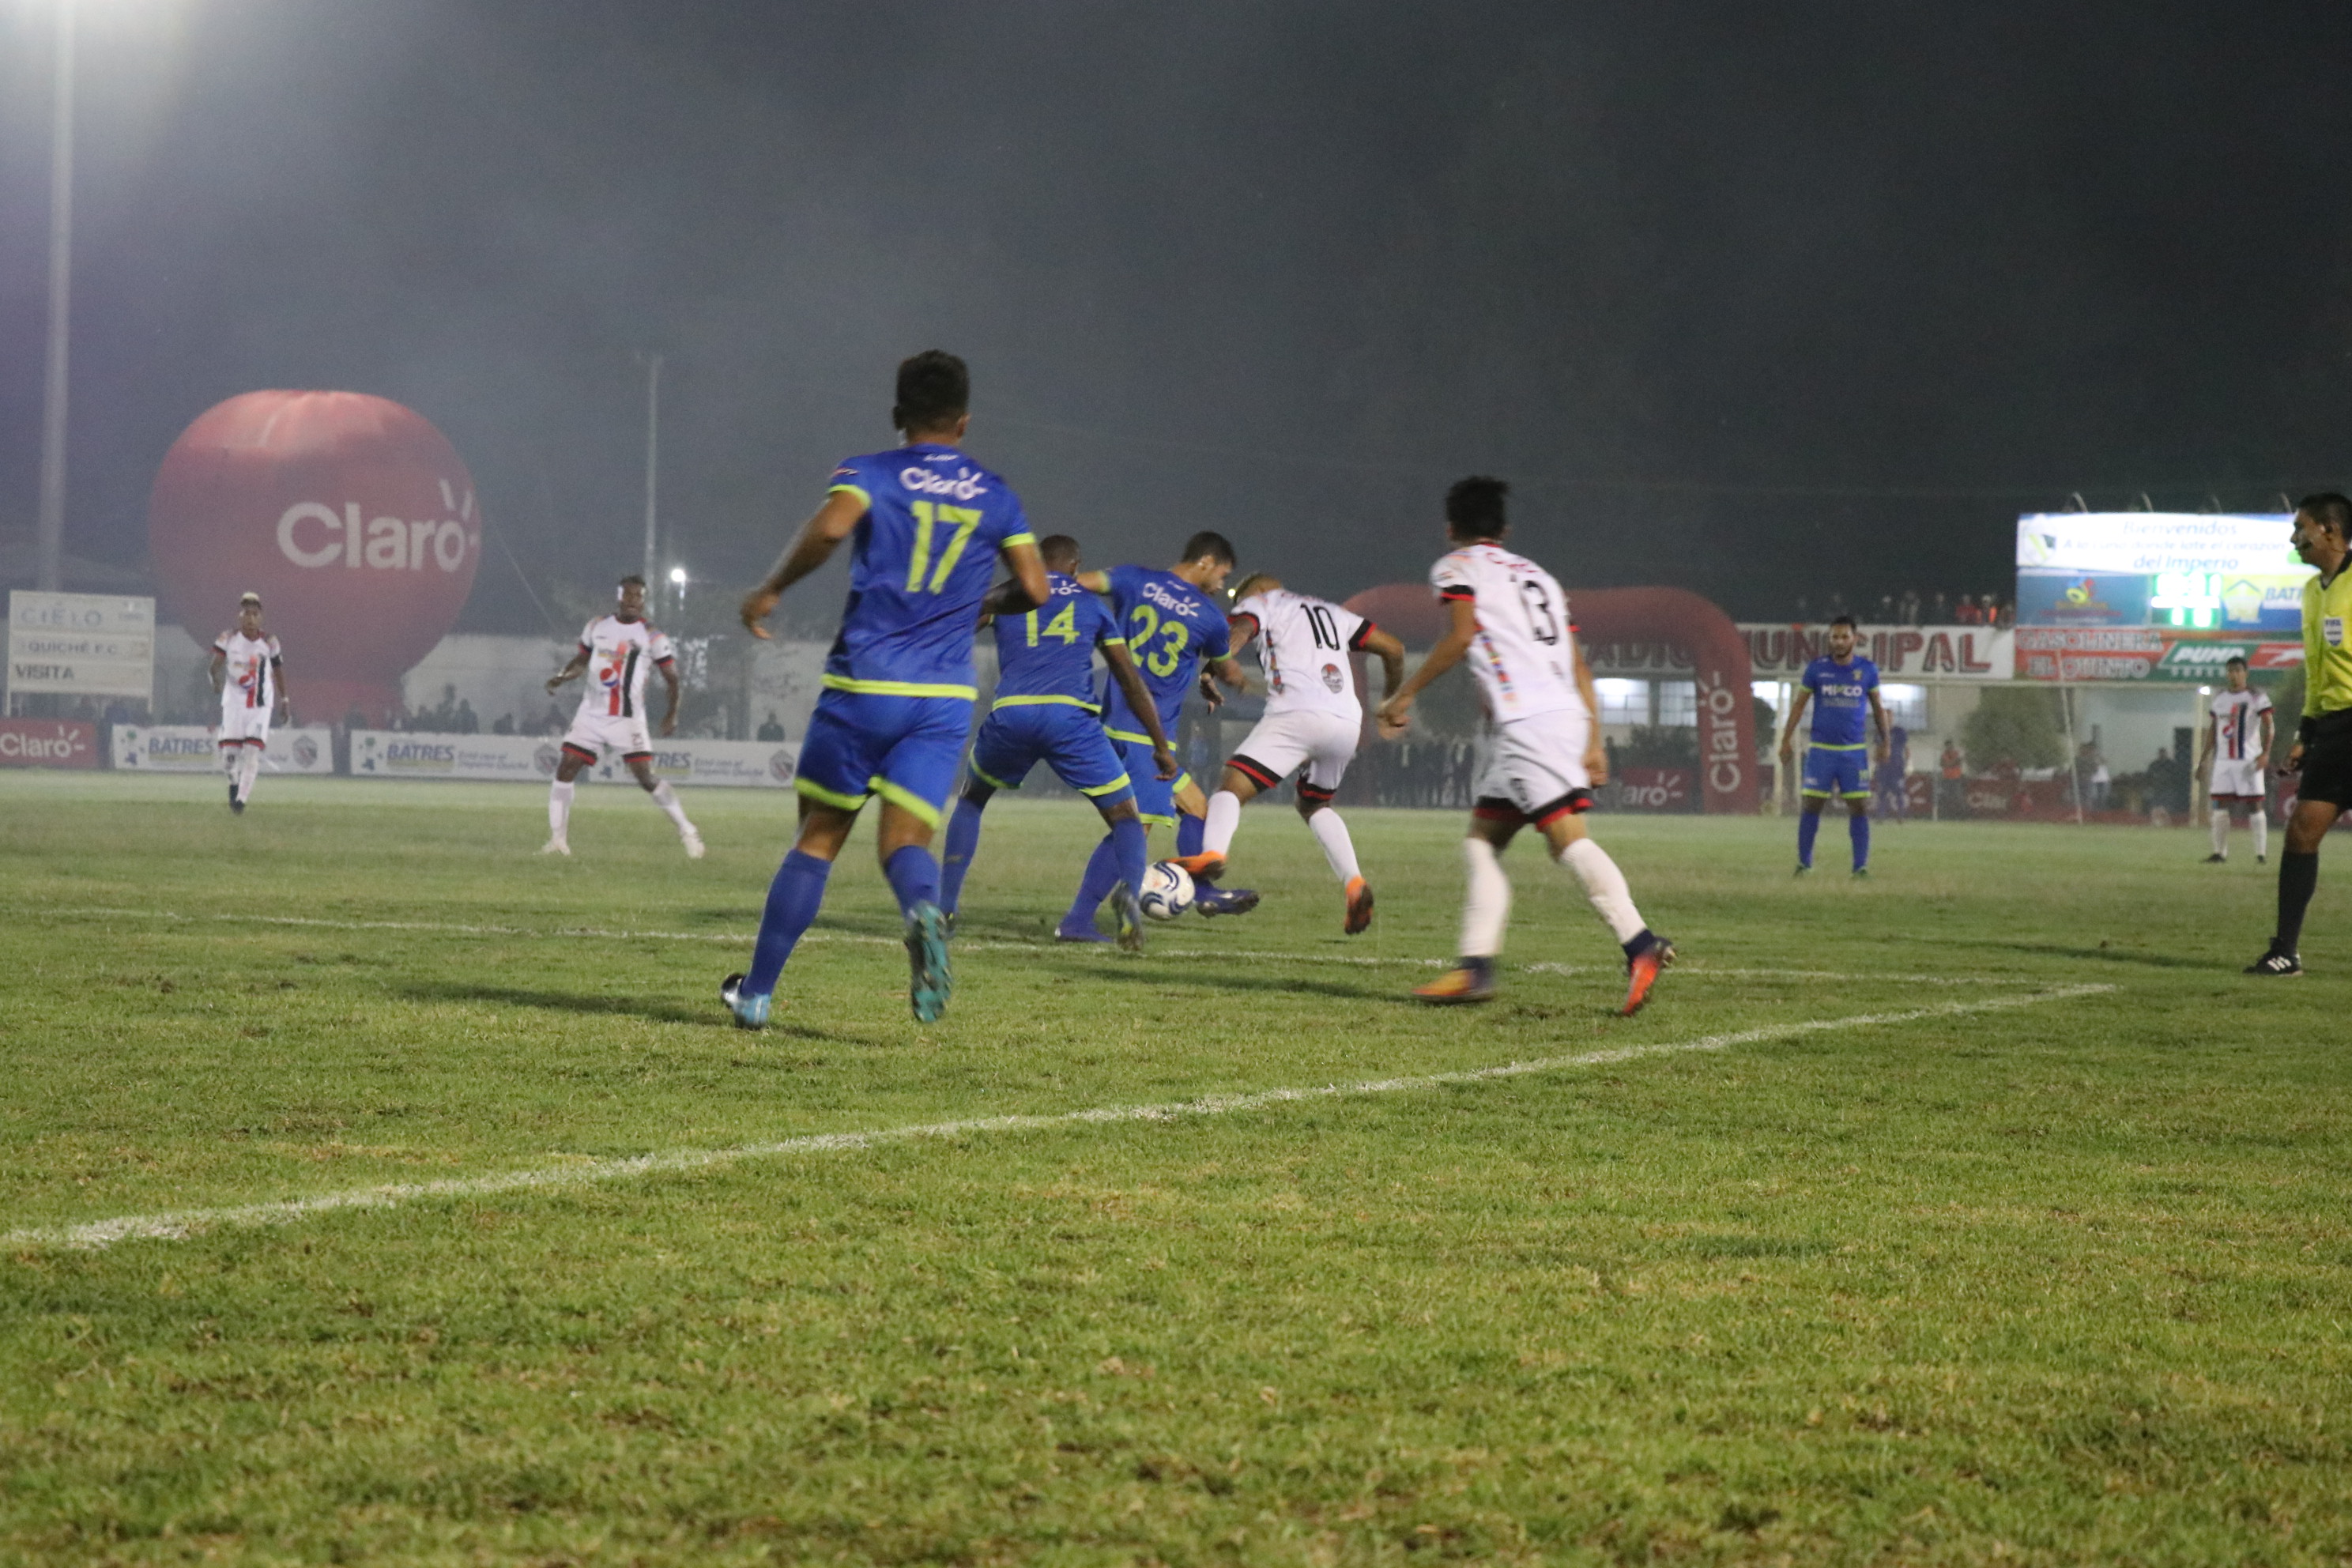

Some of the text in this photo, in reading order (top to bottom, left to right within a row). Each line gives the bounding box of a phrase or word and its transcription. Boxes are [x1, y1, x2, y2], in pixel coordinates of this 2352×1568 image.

[899, 467, 981, 500] Claro
[278, 499, 466, 572] Claro
[906, 500, 982, 594] 17
[1142, 582, 1197, 617] Claro
[1026, 601, 1080, 646] 14
[1129, 605, 1189, 677] 23
[1300, 603, 1340, 651] 10
[2018, 631, 2164, 652] GASOLINERA
[15, 664, 75, 680] VISITA
[2062, 656, 2151, 680] QUINTO
[0, 730, 75, 758] Claro
[386, 744, 454, 762] BATRES
[1707, 686, 1742, 793] Claro
